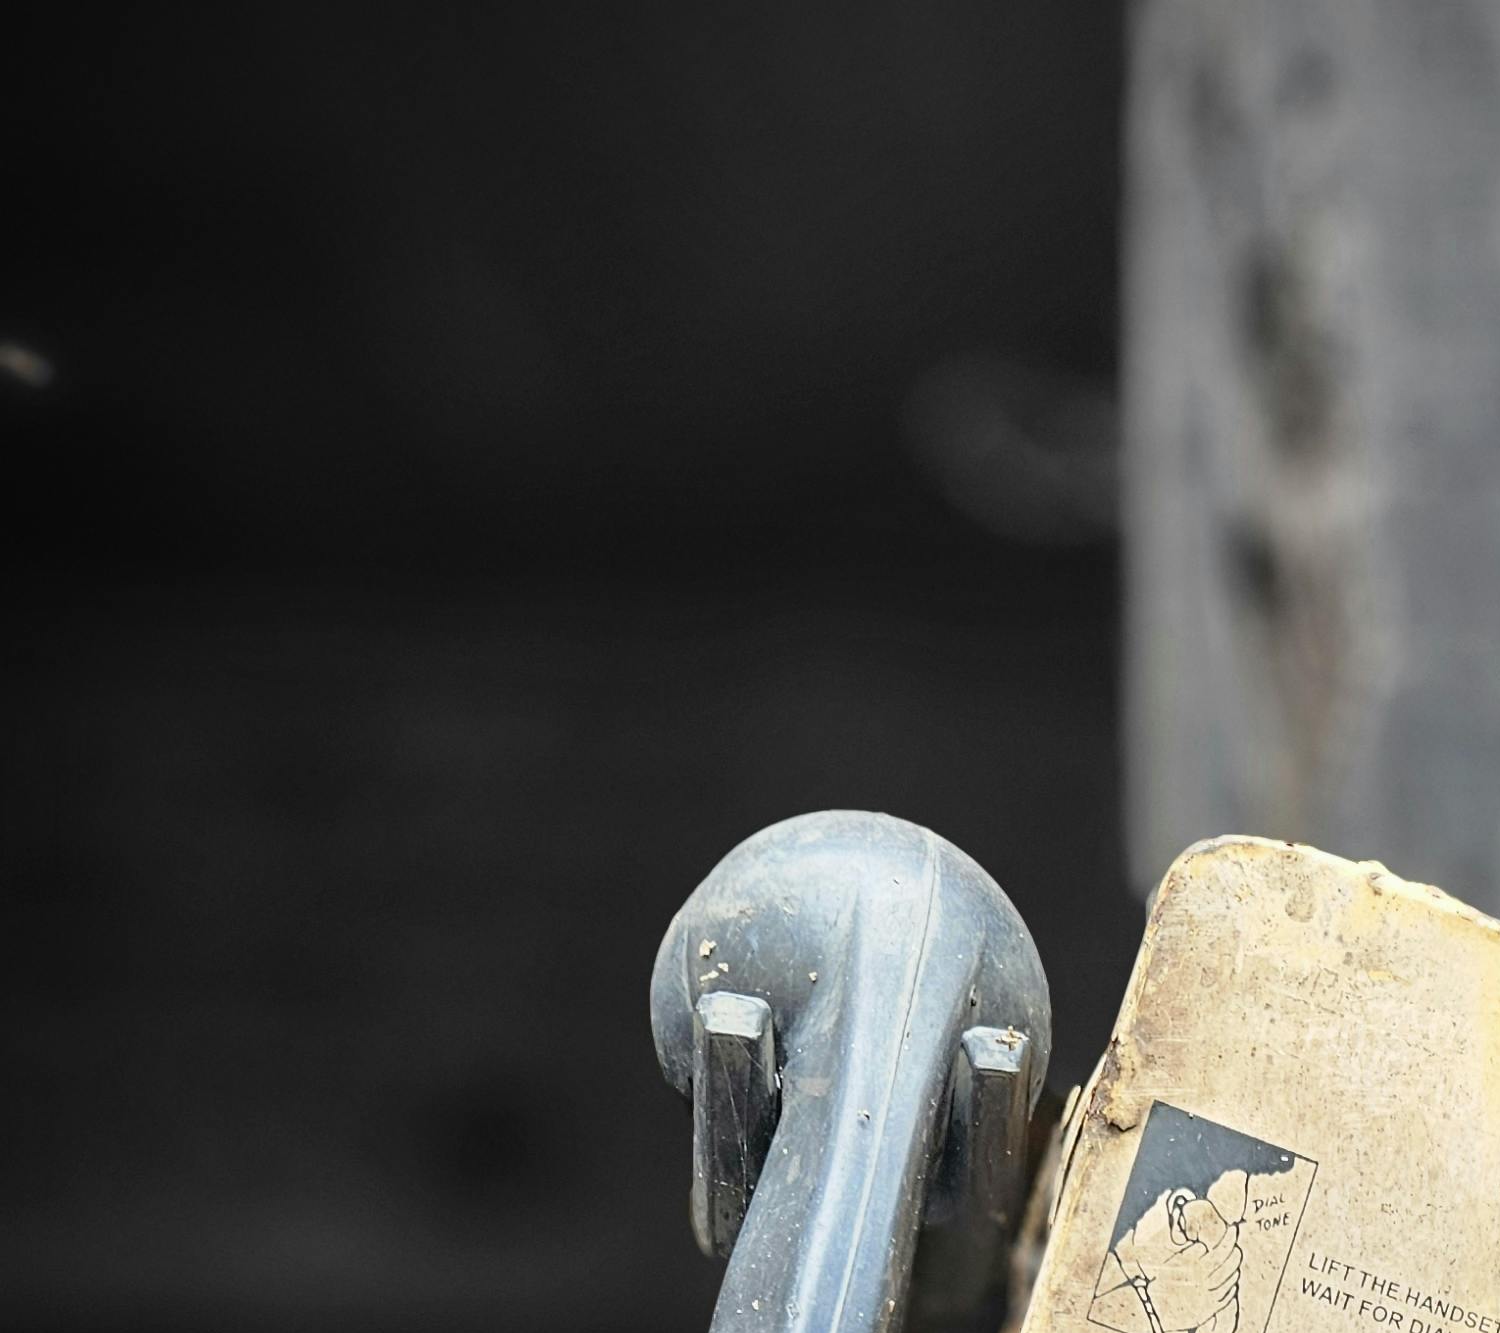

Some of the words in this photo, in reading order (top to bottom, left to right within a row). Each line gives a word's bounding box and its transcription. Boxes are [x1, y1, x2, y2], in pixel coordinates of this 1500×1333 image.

[1252, 1193, 1286, 1214] DIAL
[1256, 1212, 1291, 1232] TONE
[1308, 1252, 1356, 1282] LIFT
[1358, 1272, 1399, 1299] THE
[1300, 1277, 1352, 1313] WAIT
[1358, 1300, 1404, 1331] FOR
